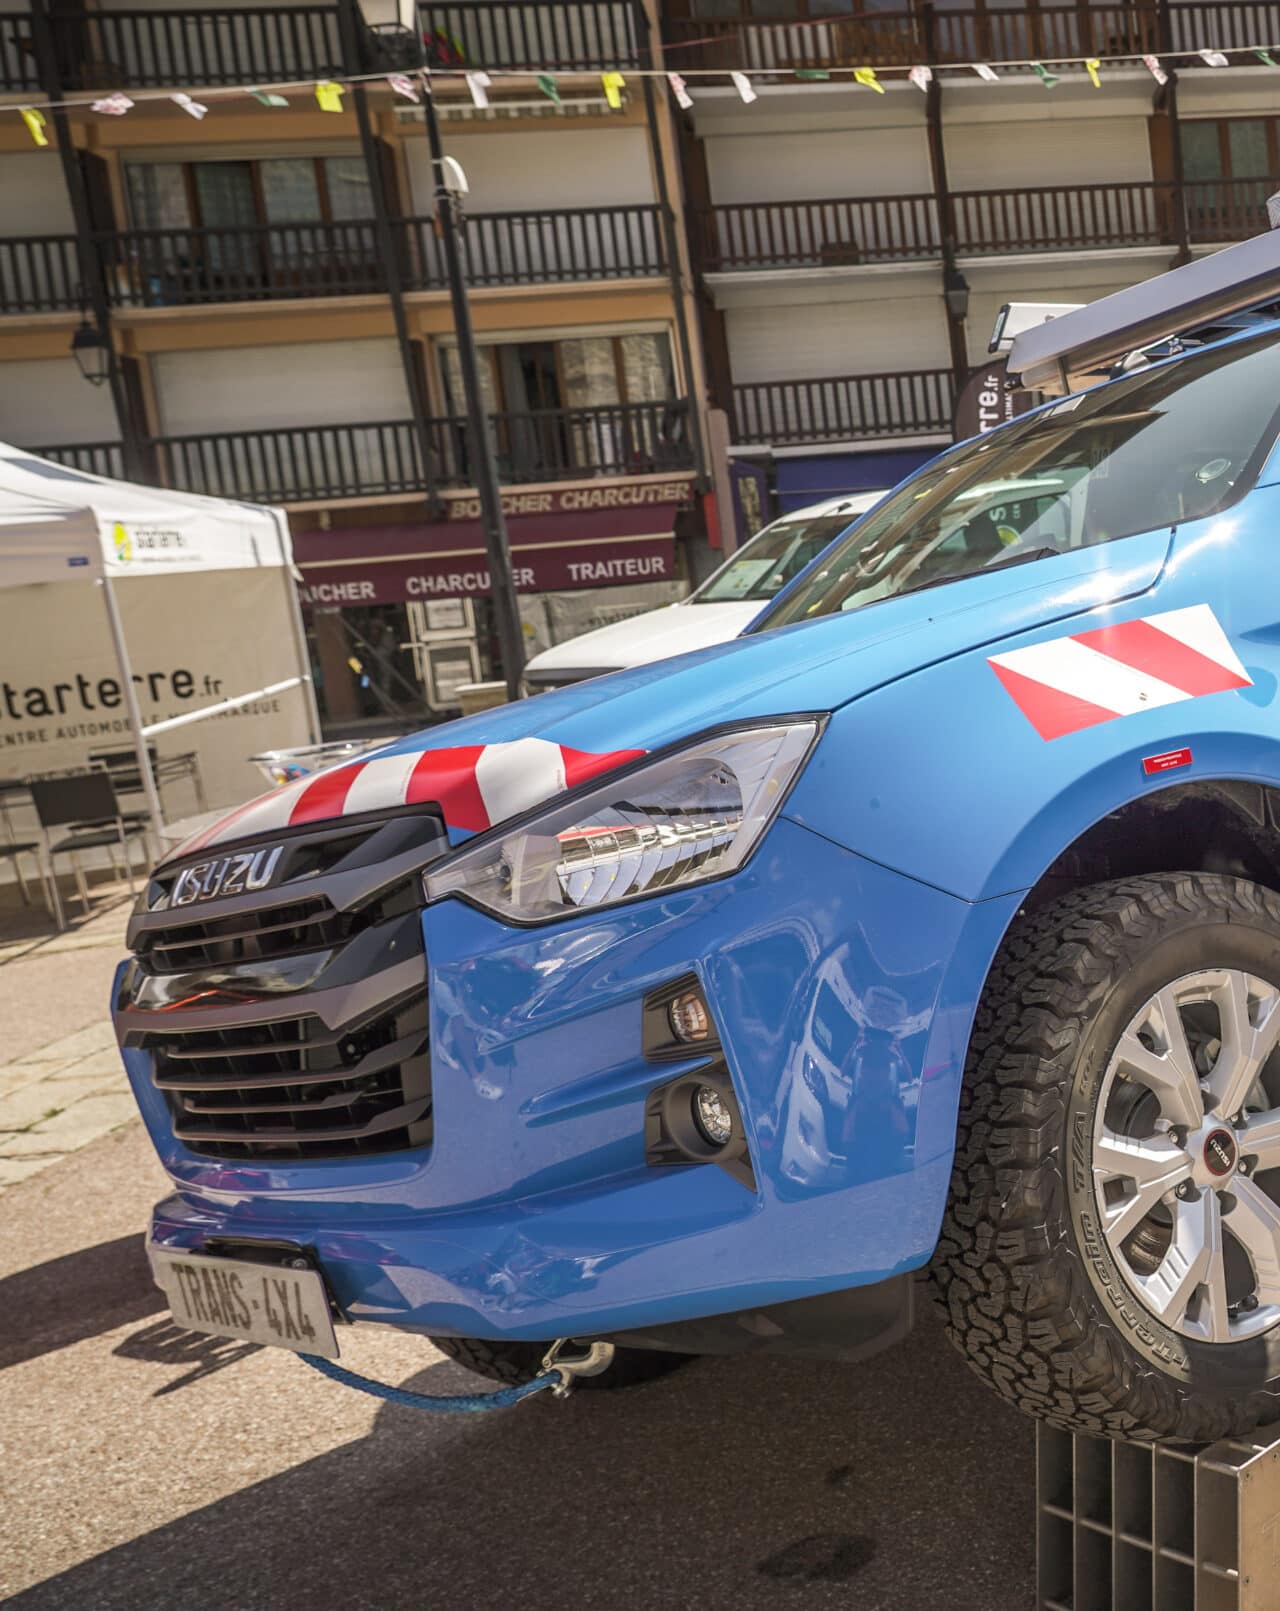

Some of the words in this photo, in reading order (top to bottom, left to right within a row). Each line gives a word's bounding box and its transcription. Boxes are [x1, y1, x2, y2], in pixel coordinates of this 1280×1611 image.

[450, 494, 552, 519] BOCHER
[560, 482, 689, 510] CHARCUTIER
[406, 567, 536, 595] CHARCUER
[567, 557, 666, 582] TRAITEUR
[171, 846, 284, 907] ISUZU
